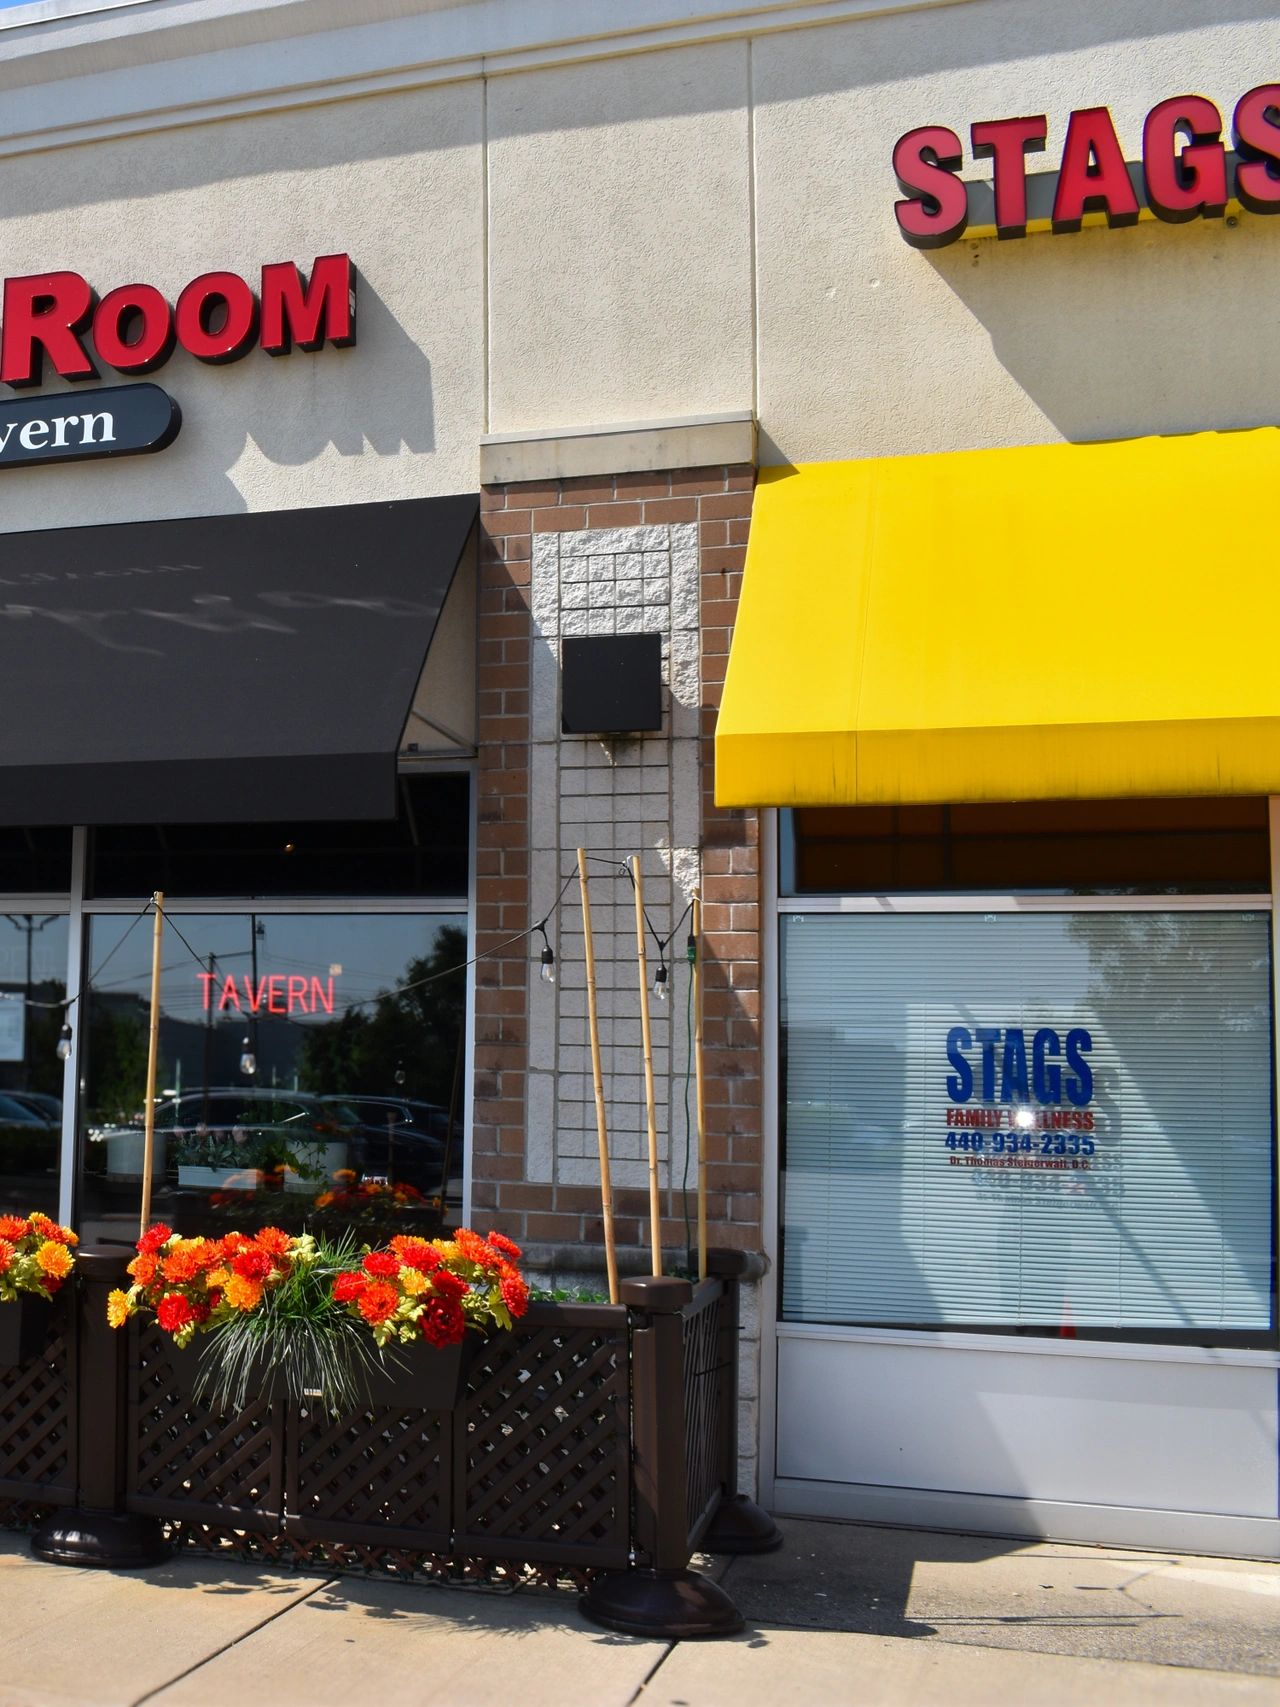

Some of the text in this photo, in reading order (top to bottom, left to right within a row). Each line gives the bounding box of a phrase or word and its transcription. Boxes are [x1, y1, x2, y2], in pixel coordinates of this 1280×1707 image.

[892, 83, 1280, 249] STAGS
[0, 253, 358, 389] ROOM
[196, 972, 335, 1014] TAVERN
[946, 1026, 1094, 1107] STAGS
[946, 1108, 1001, 1128] FAMILY
[945, 1131, 1095, 1156] 440-934-2335
[950, 1155, 963, 1166] Dr.
